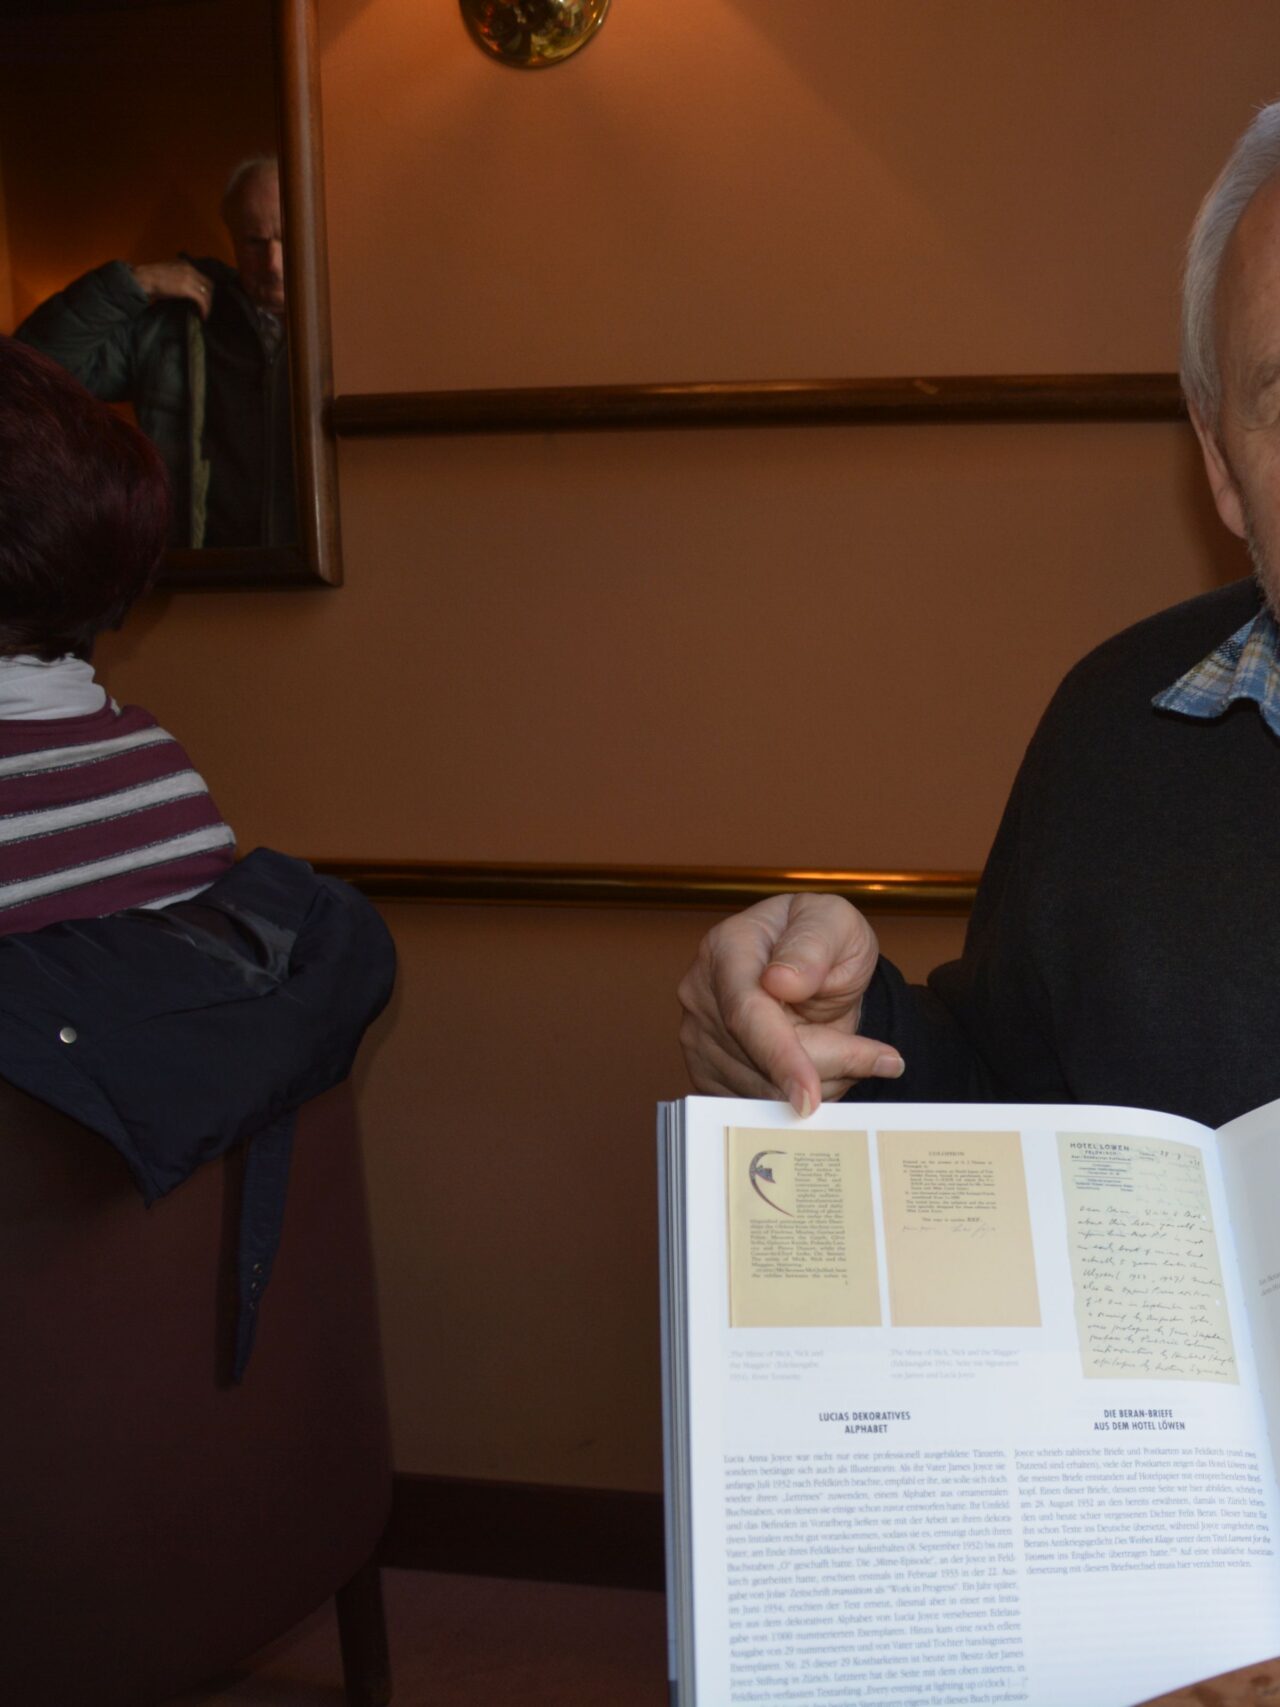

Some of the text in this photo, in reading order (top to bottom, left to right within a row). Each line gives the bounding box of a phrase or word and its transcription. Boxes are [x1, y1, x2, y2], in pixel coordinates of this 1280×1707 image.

[819, 1411, 911, 1421] LUCIAS DEKORATIVES
[1104, 1409, 1173, 1418] DIE BERAN-BRIEFE
[844, 1424, 888, 1434] ALPHABET
[1094, 1419, 1186, 1431] AUS DEM HOTEL LÖWEN
